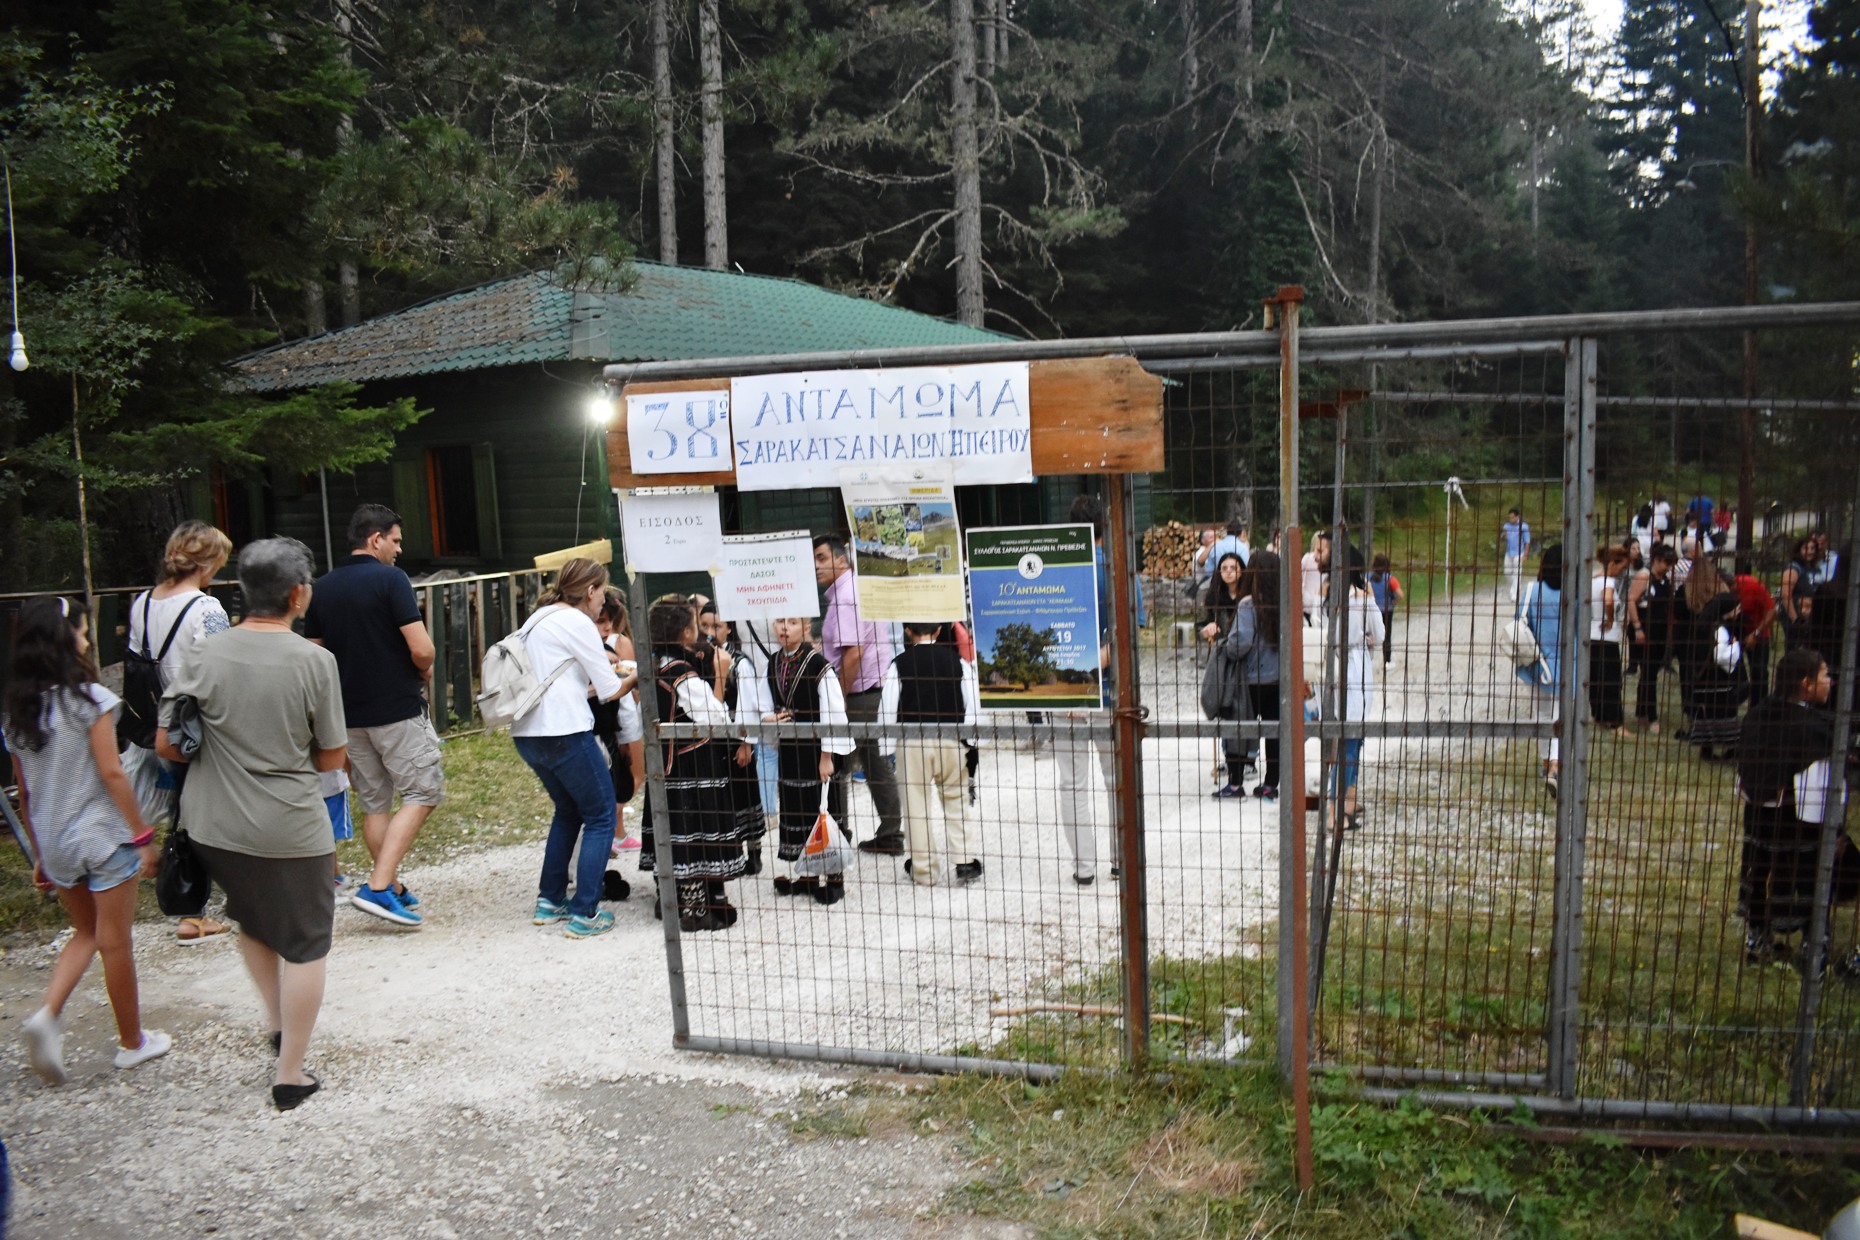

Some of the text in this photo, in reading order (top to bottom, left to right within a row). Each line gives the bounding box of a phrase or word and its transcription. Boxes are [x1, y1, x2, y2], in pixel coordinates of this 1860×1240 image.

[751, 378, 1021, 429] ΑΝΤΑΜΩΜΑ
[737, 431, 945, 466] ΣΑΡΑΚΑΤΣΑΝΑΙΩΝ
[639, 515, 704, 528] ΕΙΣΟΔΟΣ
[665, 535, 671, 545] 2
[729, 555, 796, 567] ΠΡΟΣΤΑΤΕΨΤΕ ΤΟ
[750, 570, 776, 579] ΔΑΣΟΣ
[736, 582, 795, 594] ΜΗΝ ΑΦΗΝΕΤΕ
[1016, 584, 1066, 595] ΑΝΤΑΜΩΜΑ
[747, 596, 788, 605] ΣΚΟΥΠΙΔΙΑ
[1056, 630, 1072, 643] 19
